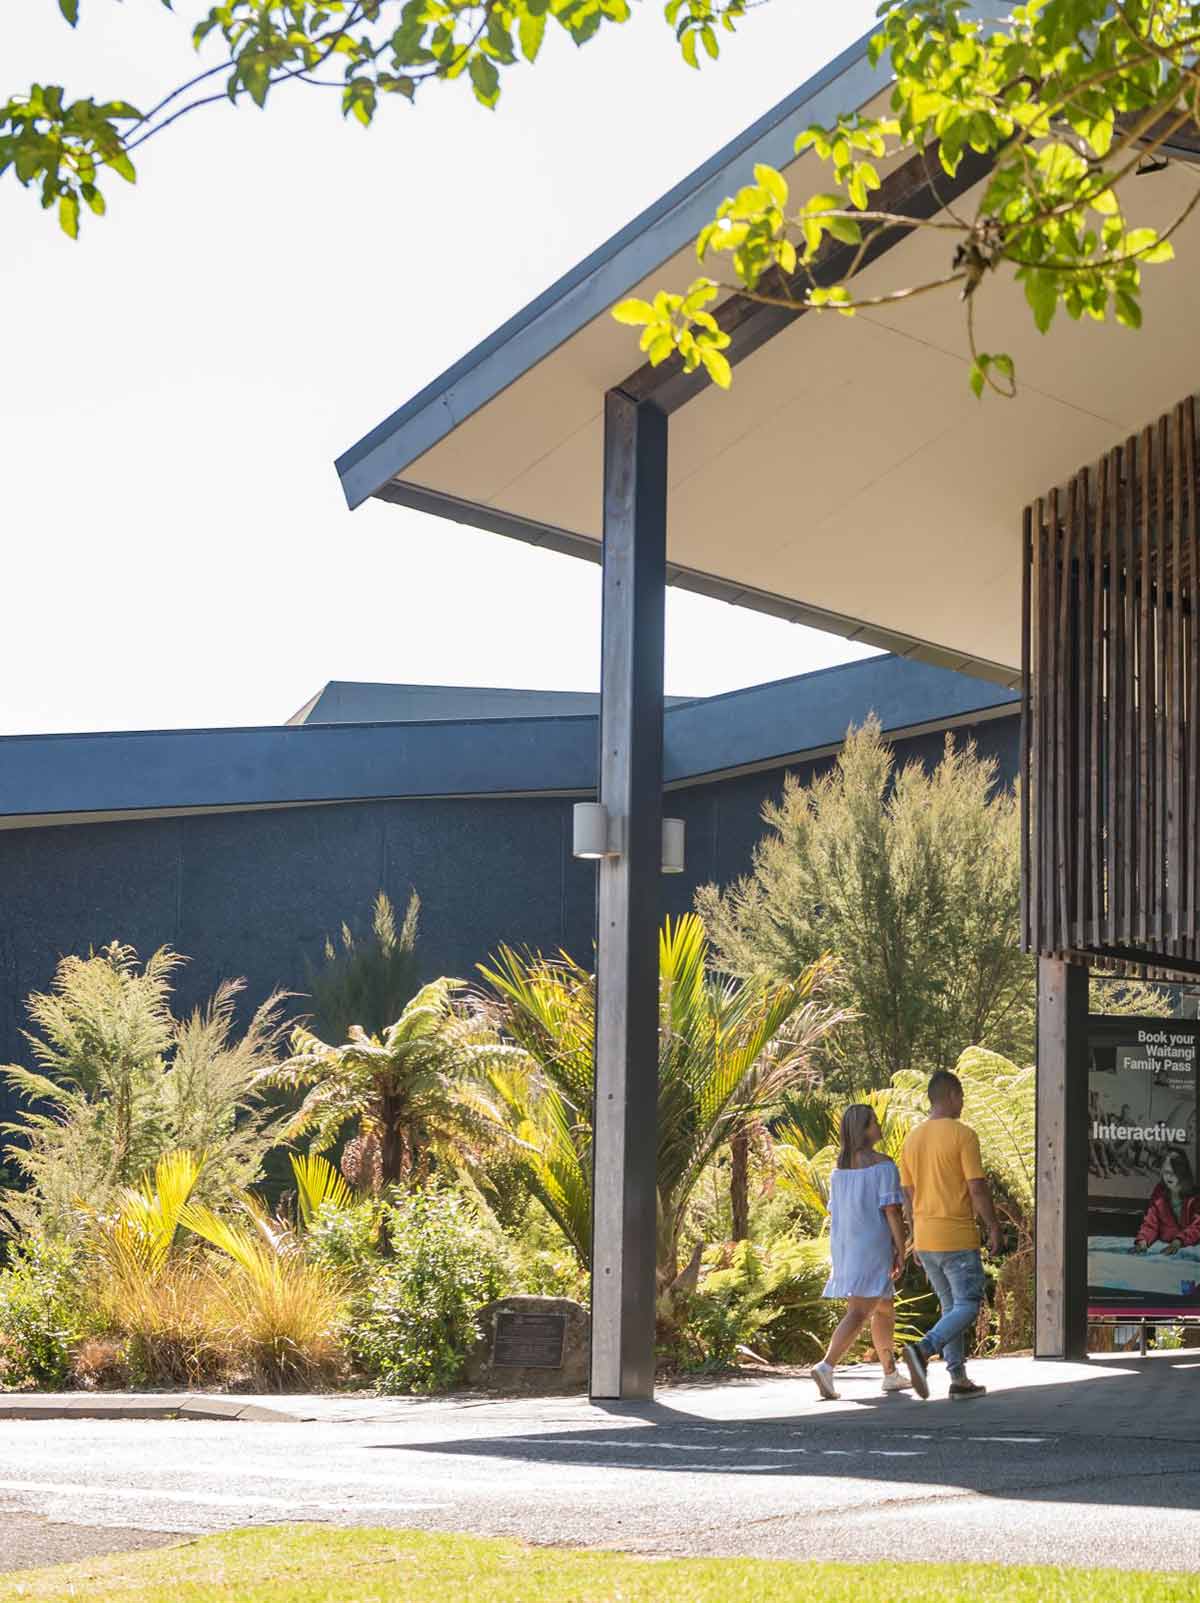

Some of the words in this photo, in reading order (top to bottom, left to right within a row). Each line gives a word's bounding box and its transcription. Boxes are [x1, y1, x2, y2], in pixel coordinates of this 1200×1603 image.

[1137, 1030, 1168, 1044] Book
[1169, 1034, 1195, 1047] your
[1145, 1044, 1196, 1061] Waitangi
[1123, 1056, 1162, 1073] Family
[1163, 1059, 1192, 1072] Pass
[1092, 1120, 1187, 1142] Interactive
